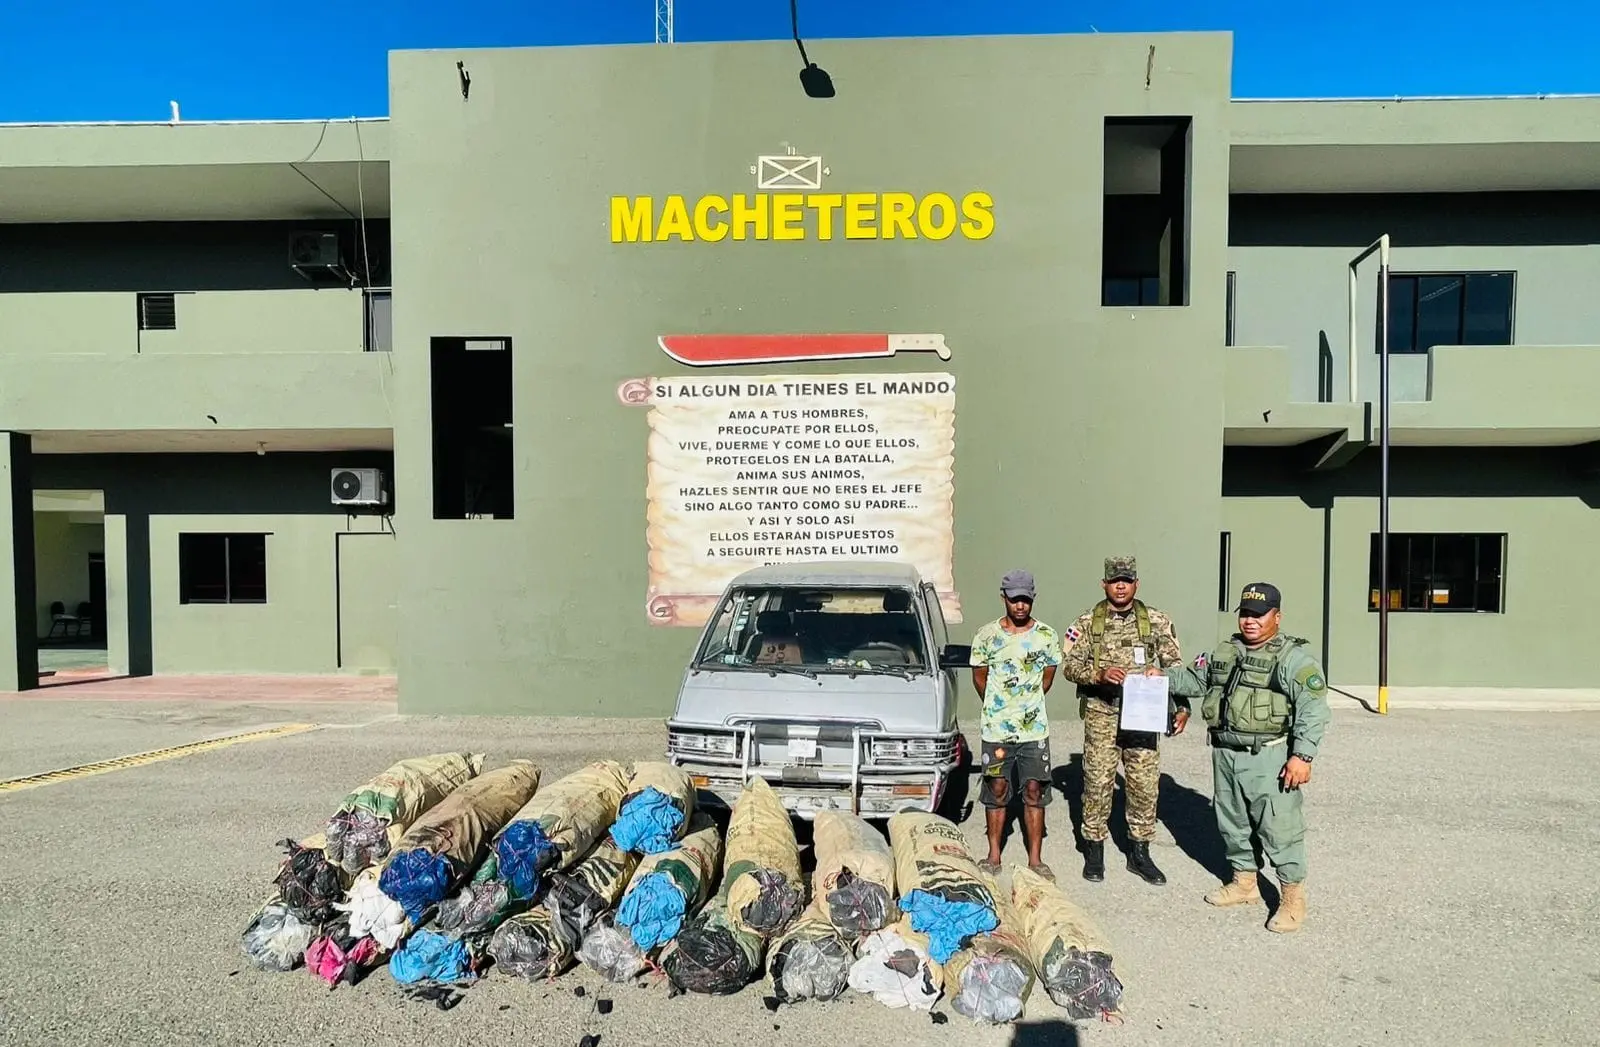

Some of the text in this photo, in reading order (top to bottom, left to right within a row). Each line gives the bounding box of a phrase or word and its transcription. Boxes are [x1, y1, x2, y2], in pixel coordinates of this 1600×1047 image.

[611, 192, 995, 242] MACHETEROS
[655, 381, 950, 398] SI ALGUN DIA TIENES EL MANDO
[728, 408, 869, 420] AMA A TUS HOMBRES,
[717, 423, 879, 436] PREOCUPATE POR ELLOS,
[678, 438, 920, 452] VIVE, DUERME Y COME LO QUE ELLOS,
[706, 453, 895, 466] PROTEGELOS EN LA BATALLA,
[736, 469, 865, 481] ANIMA SUS ANIMOS,
[679, 483, 922, 497] HAZLES SENTIR QUE NO ERES EL JEFE
[684, 499, 918, 512] SINO ALGO TANTO COMO SU PADRE...
[746, 514, 855, 526] Y ASI Y SOLO ASI
[709, 529, 895, 542] ELLOS ESTARAN DISPUESTOS
[706, 544, 899, 557] A SEGUIRTE HASTA EL ULTIMO
